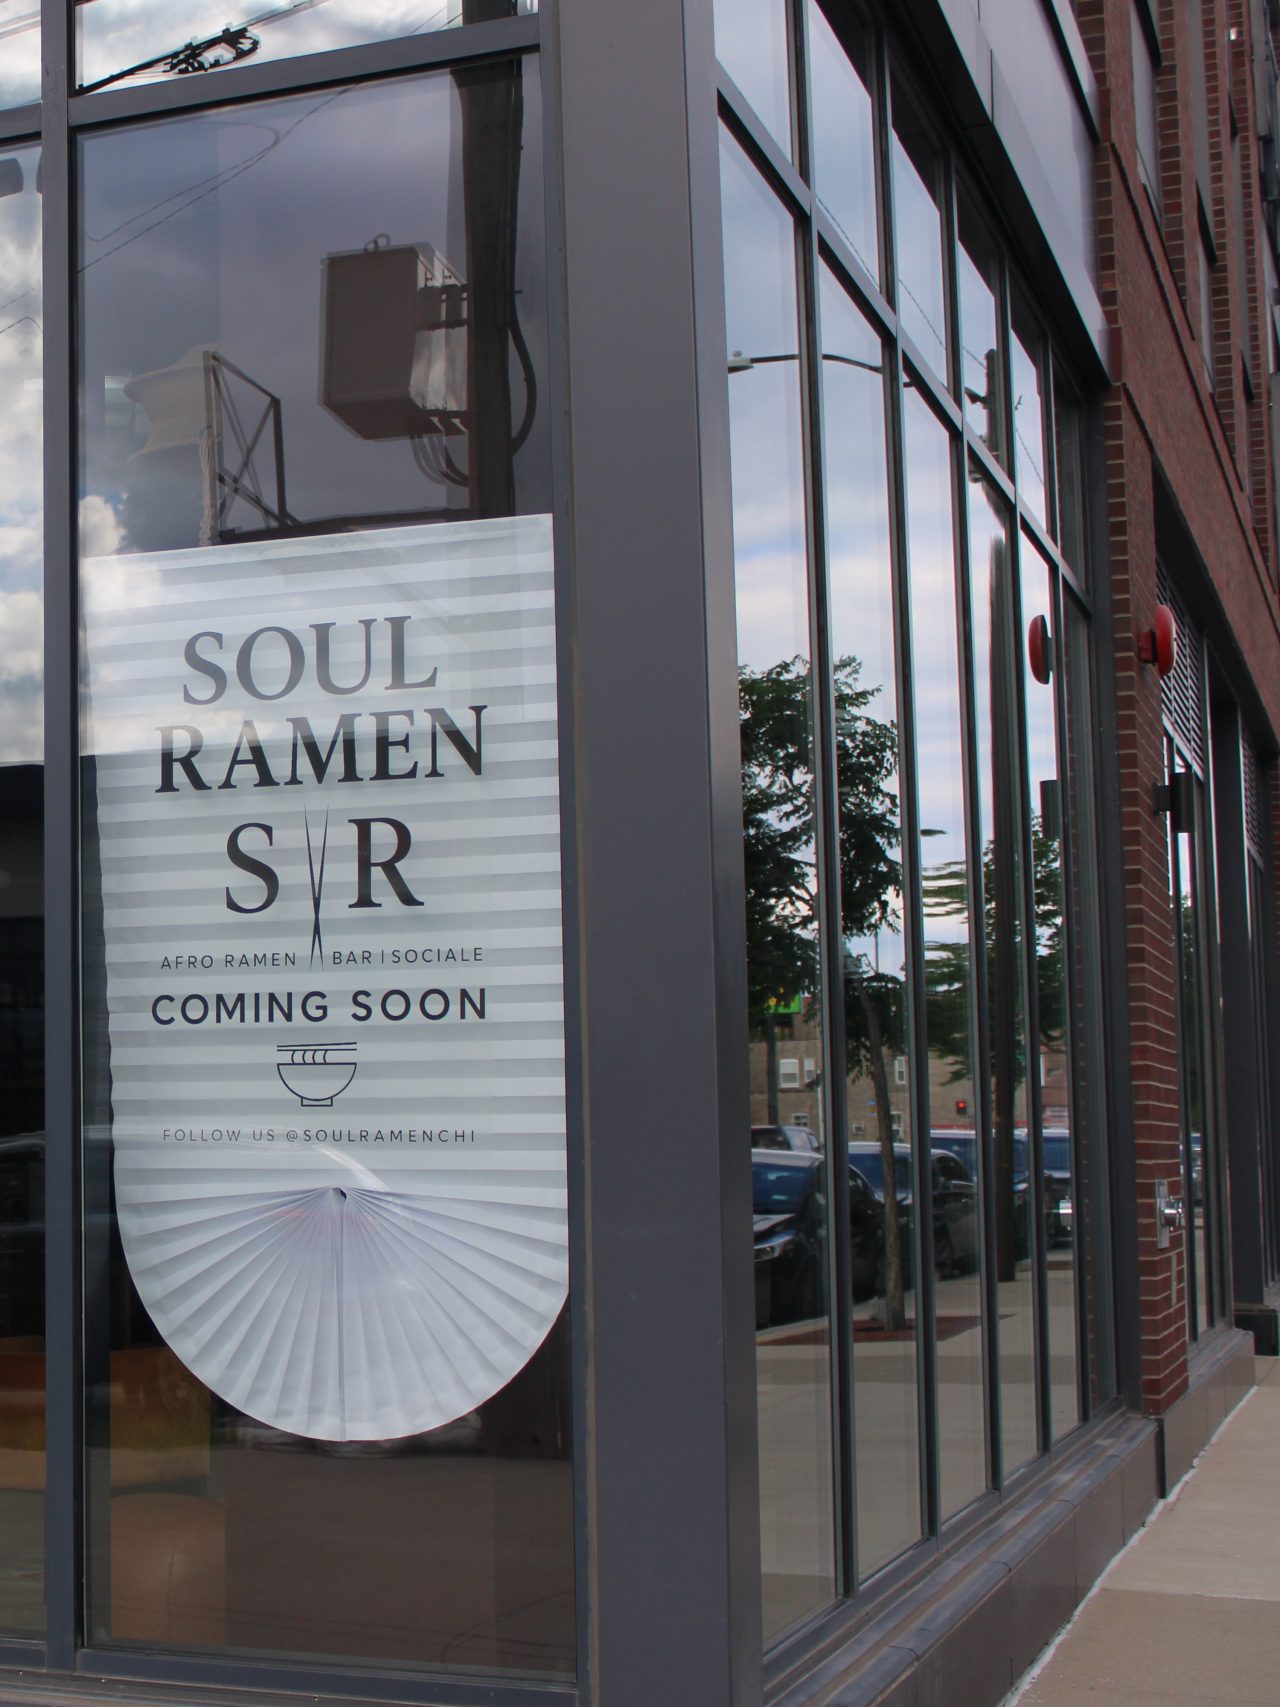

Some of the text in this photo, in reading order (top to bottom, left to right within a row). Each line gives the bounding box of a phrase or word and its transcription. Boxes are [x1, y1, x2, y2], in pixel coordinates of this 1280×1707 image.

[182, 615, 438, 706] SOUL
[154, 704, 488, 794] RAMEN
[225, 816, 425, 914] S R
[160, 954, 214, 971] AFRO
[224, 951, 297, 969] RAMEN
[332, 949, 374, 966] BAR
[391, 946, 484, 964] SOCIALE
[151, 987, 487, 1026] COMING SOON
[162, 1128, 476, 1143] FOLLOW US @SOULRAMENCHI
